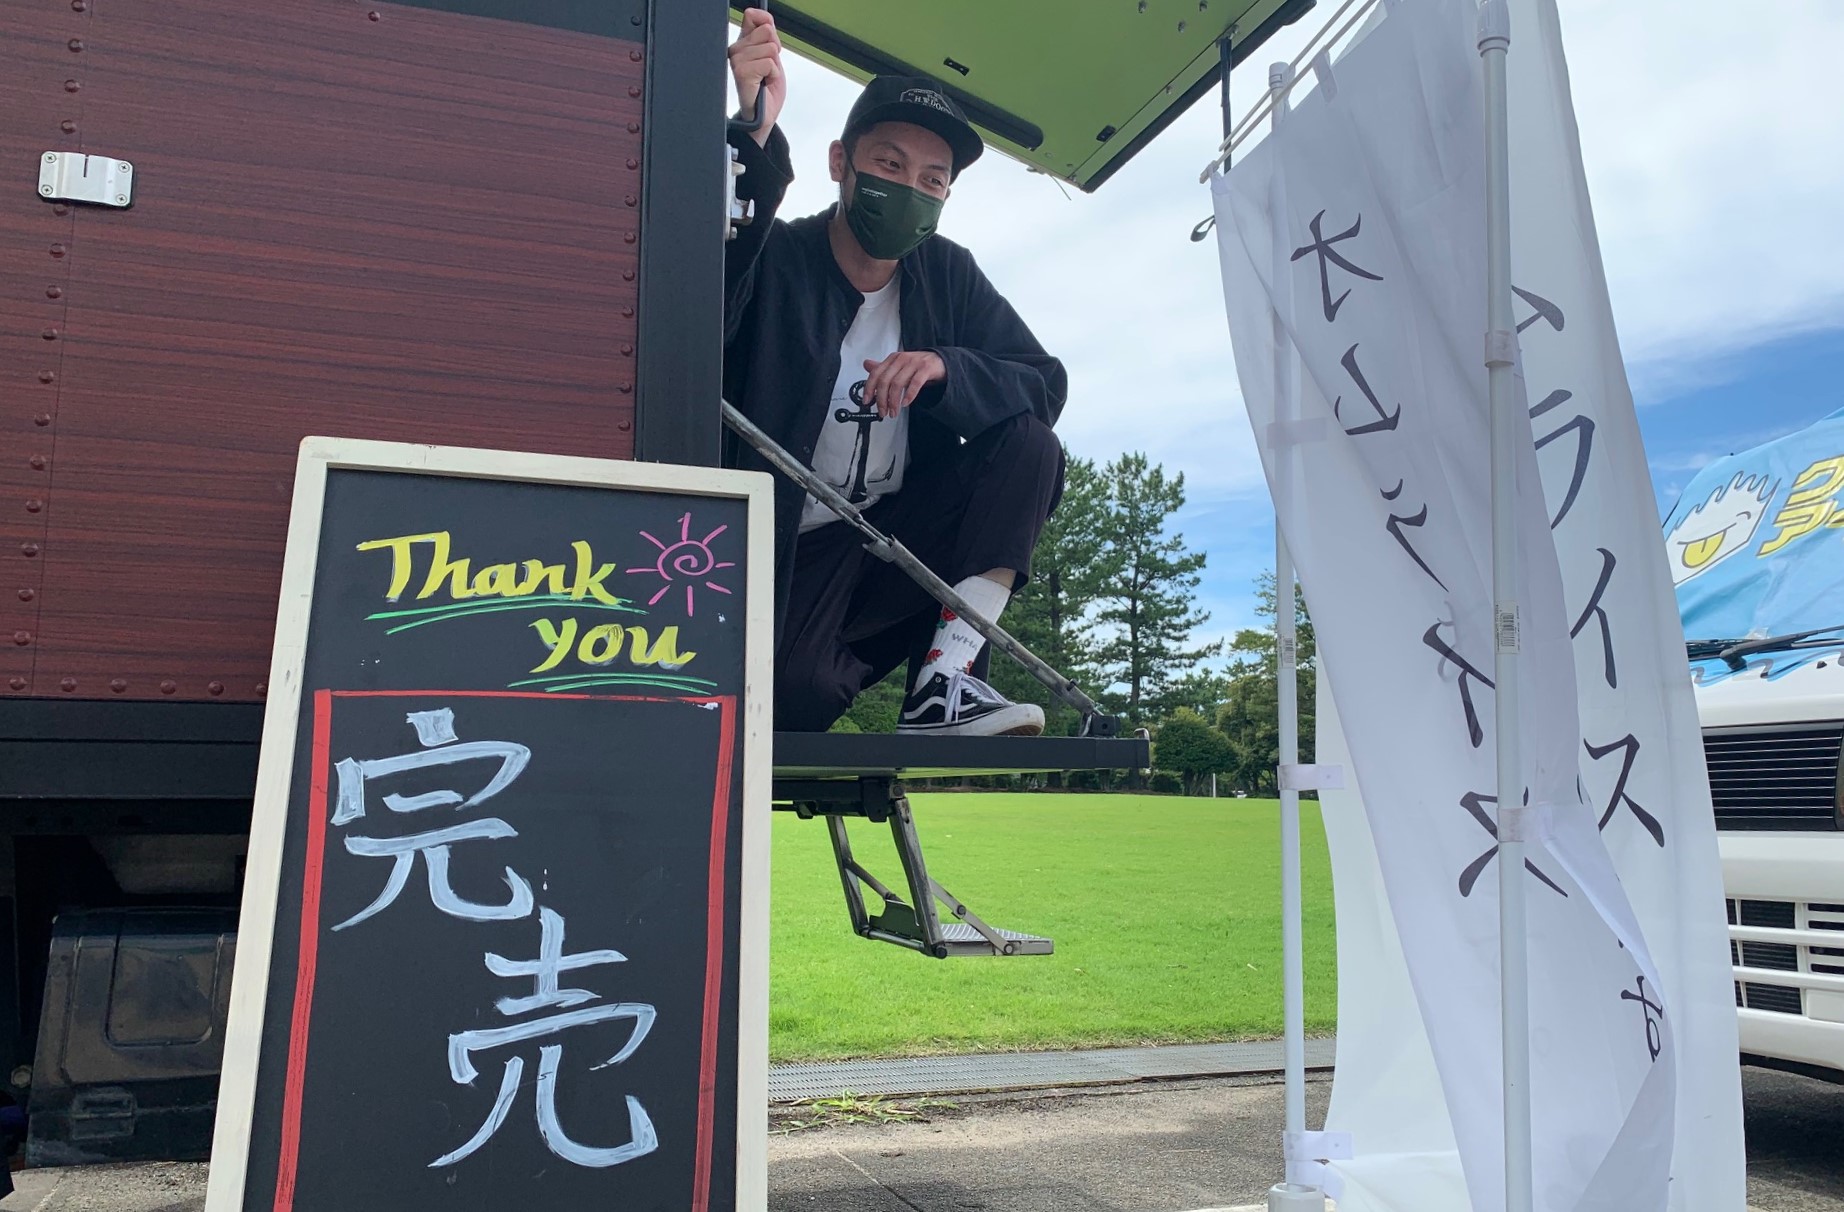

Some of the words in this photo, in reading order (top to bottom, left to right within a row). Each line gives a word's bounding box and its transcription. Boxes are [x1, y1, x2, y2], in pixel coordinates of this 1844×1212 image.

[356, 530, 621, 605] Thank
[529, 617, 697, 673] you
[330, 707, 659, 1168] 完売
